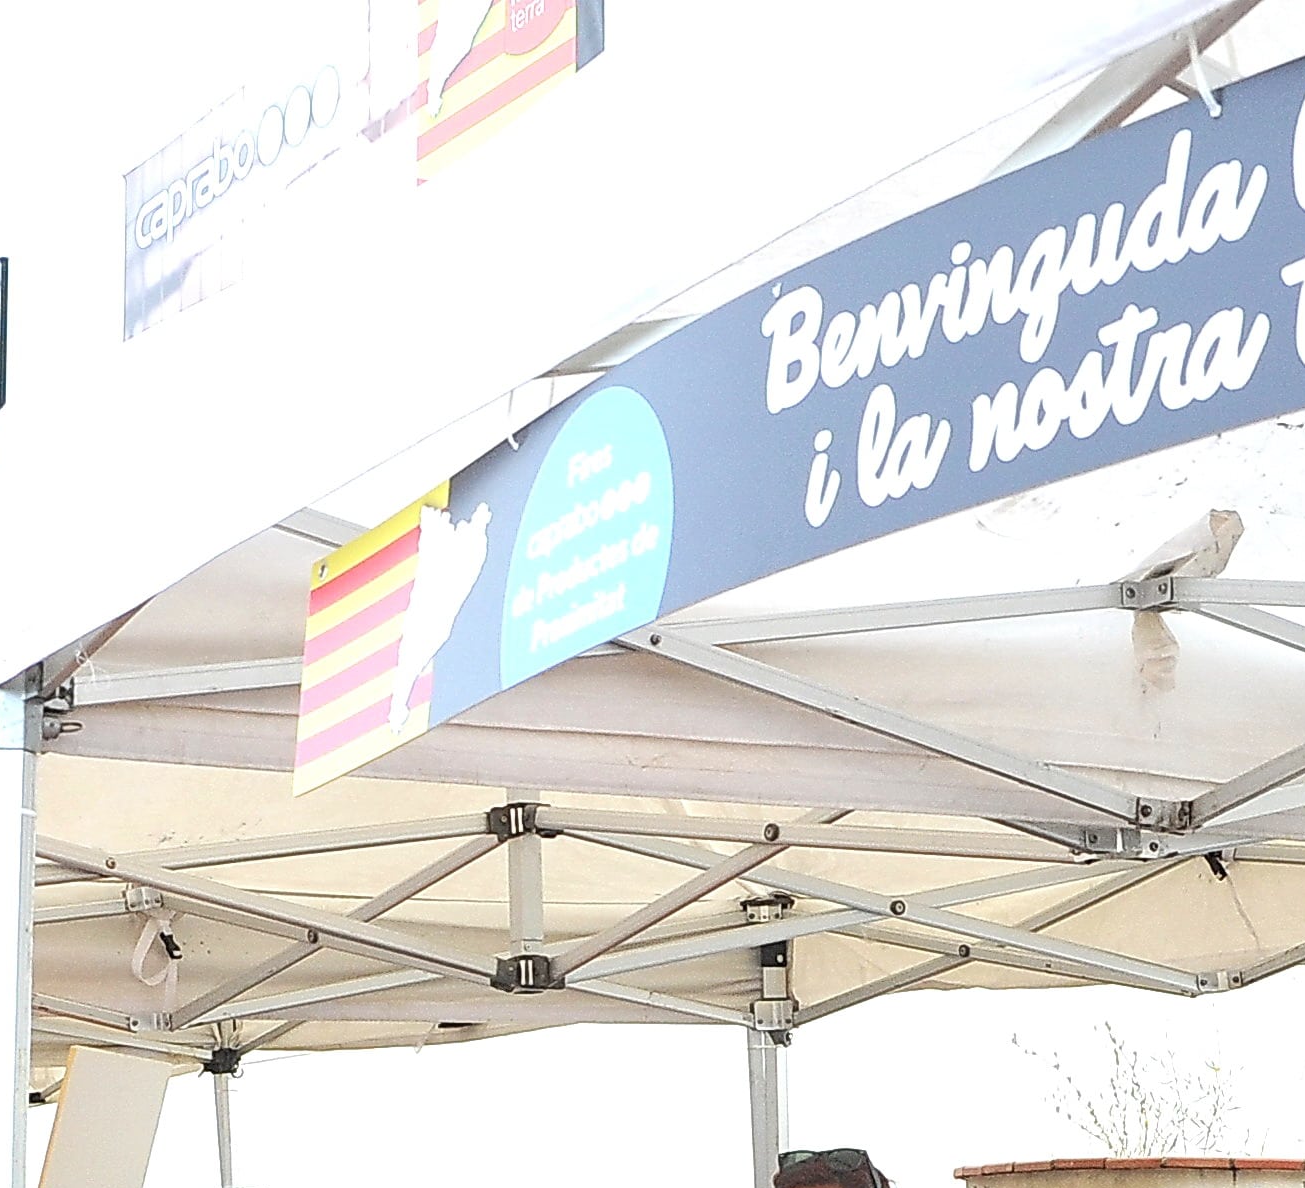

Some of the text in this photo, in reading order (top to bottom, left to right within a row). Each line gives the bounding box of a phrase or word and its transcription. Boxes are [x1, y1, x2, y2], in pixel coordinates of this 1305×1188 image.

[510, 0, 544, 32] terra
[135, 128, 255, 249] caprabo
[761, 129, 1268, 415] Benvinguda
[804, 429, 841, 527] i
[857, 383, 951, 507] la
[969, 303, 1270, 472] nostra
[567, 443, 613, 488] Fires
[527, 500, 600, 560] caprabo
[631, 522, 660, 556] de
